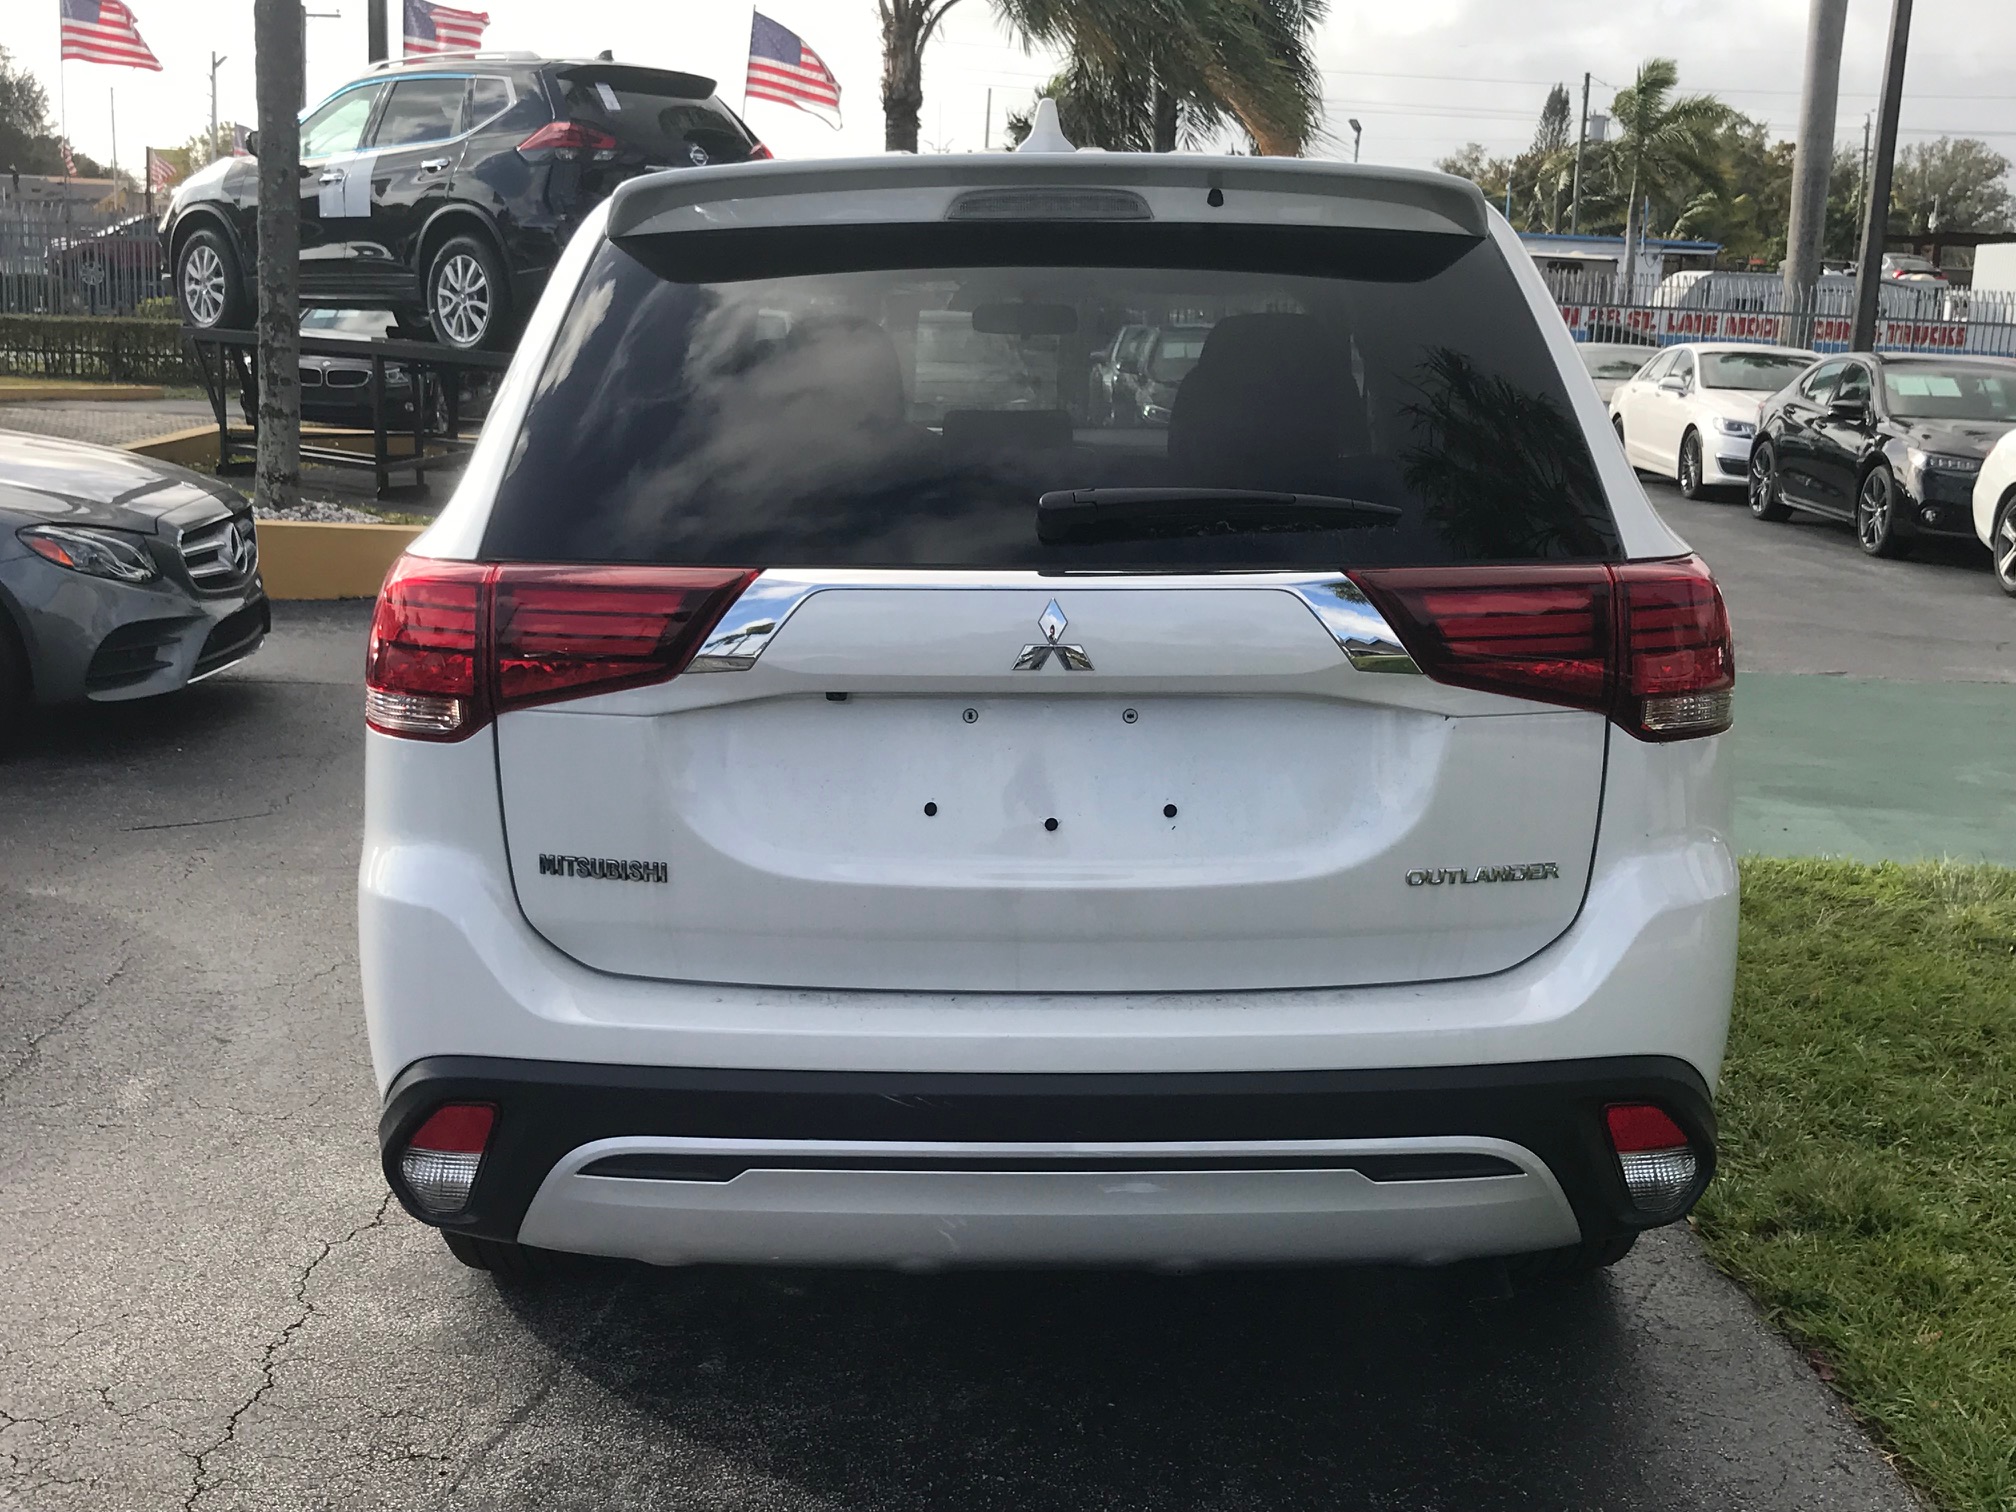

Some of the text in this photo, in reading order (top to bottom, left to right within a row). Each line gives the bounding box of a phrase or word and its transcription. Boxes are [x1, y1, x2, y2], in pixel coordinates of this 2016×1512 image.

[1725, 315, 1781, 338] MOD
[1813, 319, 1850, 341] CAR
[1887, 323, 1966, 348] TRUCKS
[538, 853, 668, 883] MITSUBISHI
[1405, 861, 1560, 887] OUTLANDER
